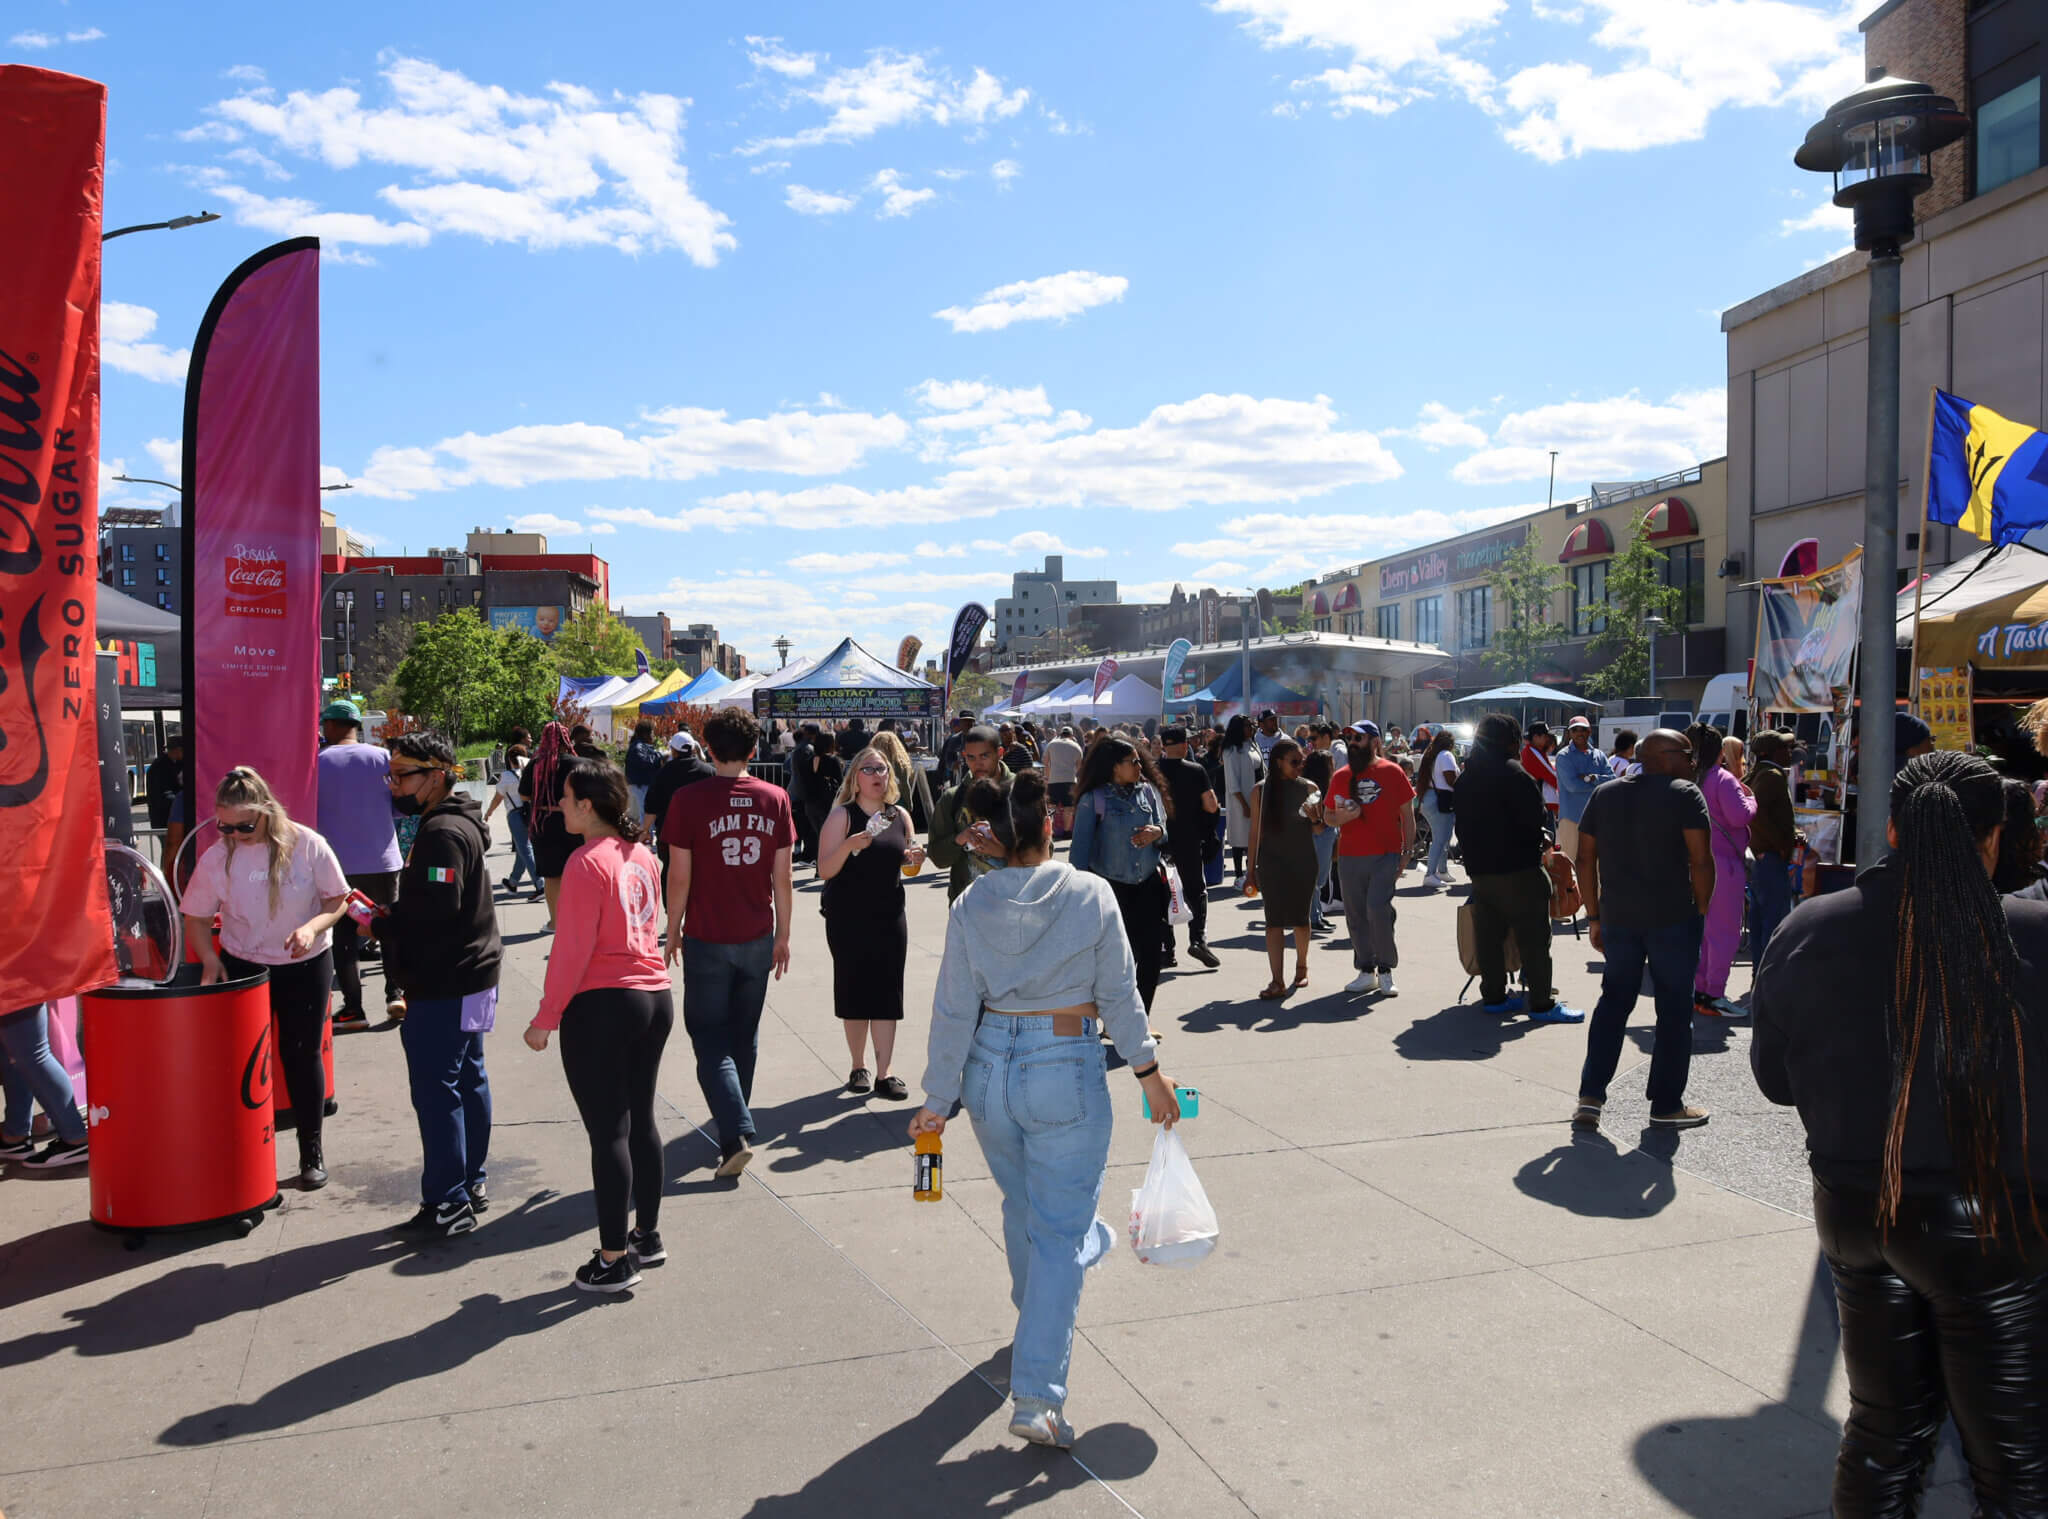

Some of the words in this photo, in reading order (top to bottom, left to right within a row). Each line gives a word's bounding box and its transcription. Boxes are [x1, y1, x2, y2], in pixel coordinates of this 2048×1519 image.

[52, 427, 85, 576] SUGAR
[1380, 567, 1410, 592] Cherry
[1418, 552, 1449, 581] Valley
[229, 605, 283, 614] CREATIONS
[233, 645, 276, 656] Move
[1977, 624, 2000, 659] A
[62, 599, 86, 721] ZERO
[800, 697, 863, 707] JAMAICAN
[865, 697, 901, 707] FOOD
[819, 689, 875, 697] ROSTACY
[746, 813, 776, 837] FAN
[721, 836, 761, 866] 23
